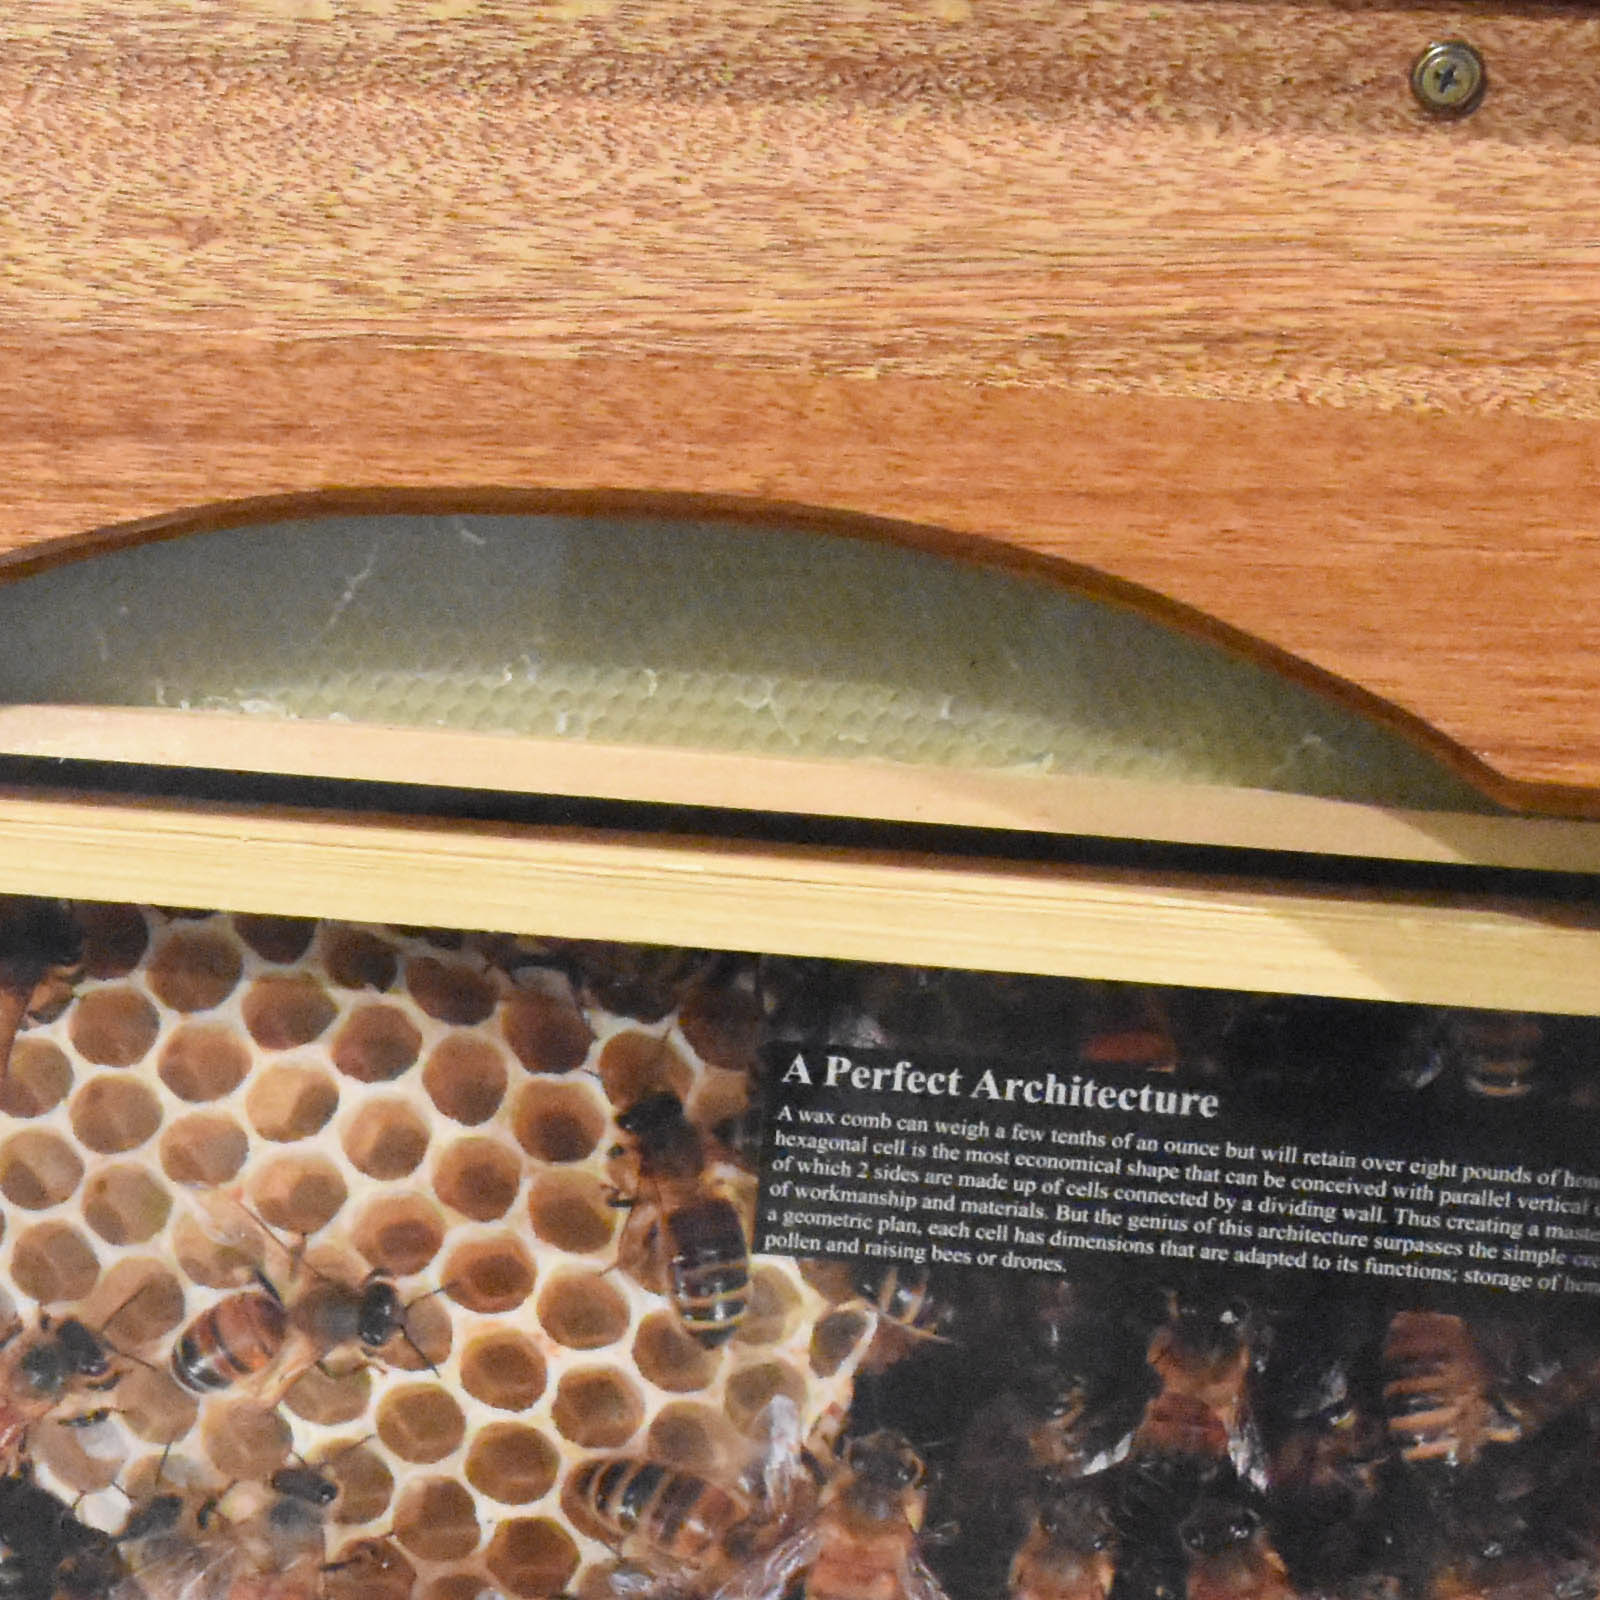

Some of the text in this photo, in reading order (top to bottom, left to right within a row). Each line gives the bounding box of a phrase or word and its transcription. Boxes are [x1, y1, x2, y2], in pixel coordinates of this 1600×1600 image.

[779, 1051, 1220, 1118] A Perfect Architecture
[774, 1129, 868, 1155] hexagonal
[872, 1138, 906, 1156] cell
[910, 1141, 927, 1158] is
[931, 1142, 961, 1161] the
[965, 1150, 1010, 1165] most
[1015, 1154, 1122, 1175] economical
[1126, 1159, 1180, 1184] shape
[1184, 1164, 1221, 1183] that
[1225, 1172, 1258, 1186] can
[1263, 1170, 1286, 1188] be
[1290, 1177, 1387, 1198] conceived
[1391, 1184, 1434, 1201] with
[1438, 1189, 1512, 1208] parallel
[1517, 1196, 1589, 1214] vertical
[775, 1104, 1561, 1186] A wax comb can weigh a few tenths of an ounce but will retain over eight pounds of
[768, 1181, 792, 1198] of
[794, 1185, 918, 1213] workmanship
[922, 1194, 956, 1212] and
[960, 1200, 1049, 1220] materials.
[1055, 1204, 1089, 1223] But
[1093, 1208, 1122, 1226] the
[1127, 1213, 1189, 1232] genius
[1192, 1216, 1216, 1234] of
[1218, 1218, 1253, 1237] this
[1256, 1223, 1369, 1247] architecture
[1373, 1236, 1463, 1256] surpasses
[1468, 1240, 1498, 1258] the
[1501, 1243, 1566, 1267] simple
[771, 1155, 1540, 1240] of which 2 sides are made up of cells connected by a dividing wall. Thus creating a
[764, 1231, 1067, 1272] pollen and raising bees or drones.
[766, 1210, 778, 1222] a
[782, 1211, 873, 1230] geometric
[878, 1215, 923, 1237] plan,
[927, 1221, 970, 1238] each
[974, 1224, 1008, 1241] cell
[1013, 1226, 1045, 1245] has
[1048, 1229, 1155, 1254] dimensions
[1159, 1239, 1195, 1258] that
[1199, 1246, 1229, 1260] are
[1233, 1245, 1306, 1269] adapted
[1312, 1256, 1331, 1271] to
[1336, 1256, 1358, 1273] its
[1463, 1269, 1533, 1292] storage
[1537, 1273, 1560, 1290] of
